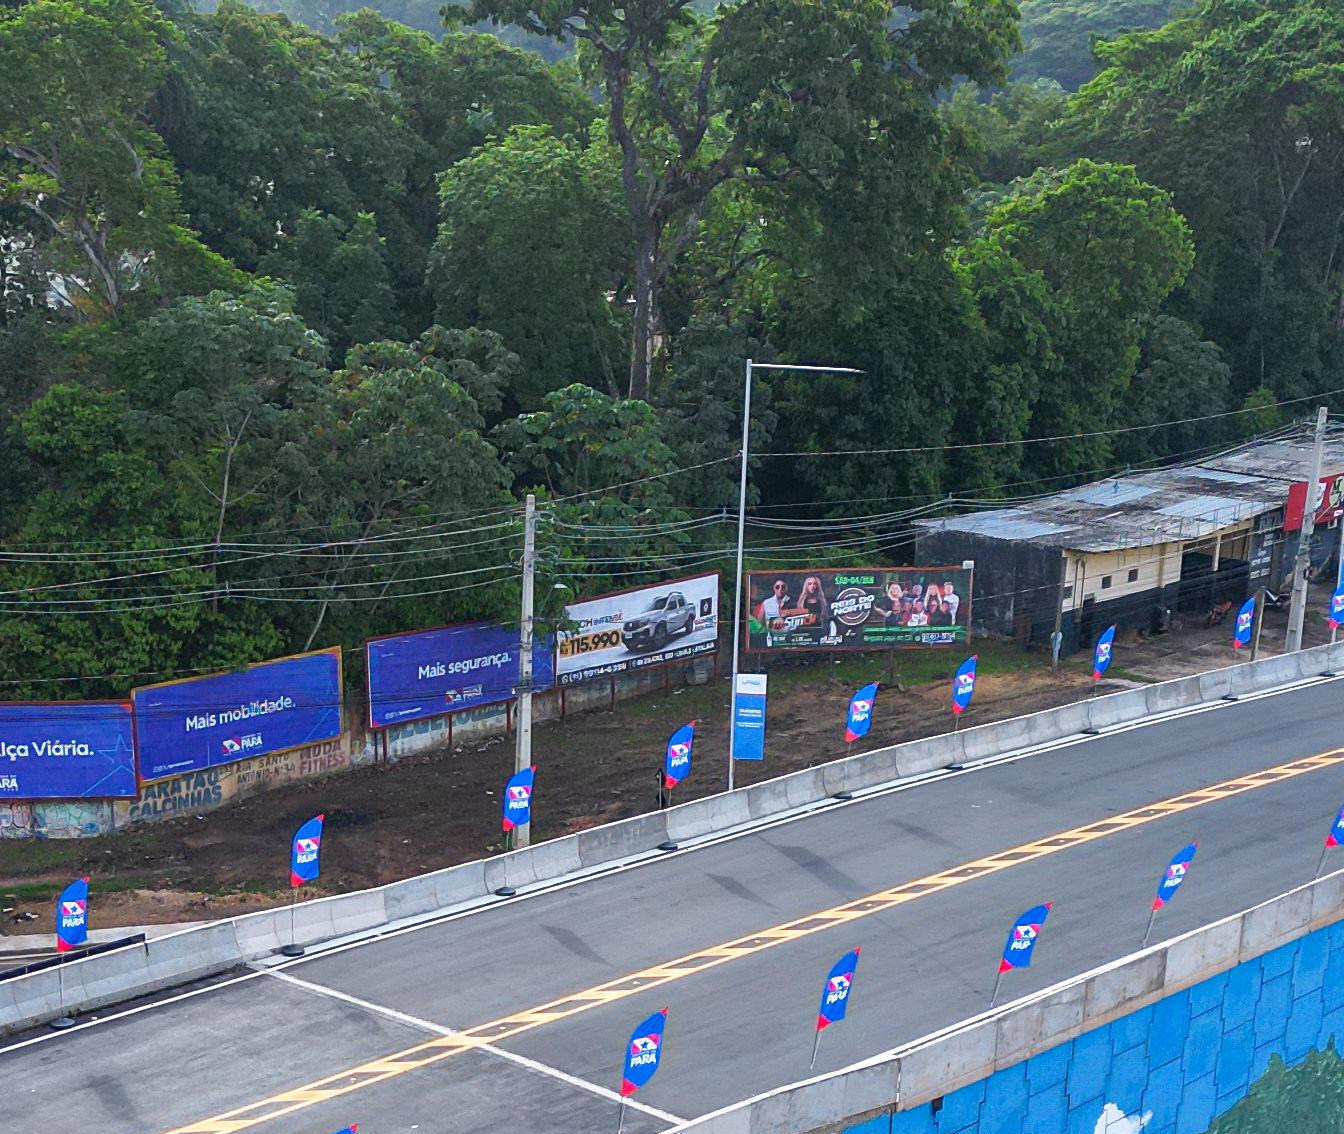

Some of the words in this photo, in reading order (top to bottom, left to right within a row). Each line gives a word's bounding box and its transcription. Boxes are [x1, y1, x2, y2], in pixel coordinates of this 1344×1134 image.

[418, 661, 446, 680] Mais
[448, 650, 512, 675] segurança.
[186, 712, 217, 732] Mais
[219, 695, 296, 725] mobilidade.
[32, 739, 95, 757] Viária.
[299, 750, 346, 775] FITNESS
